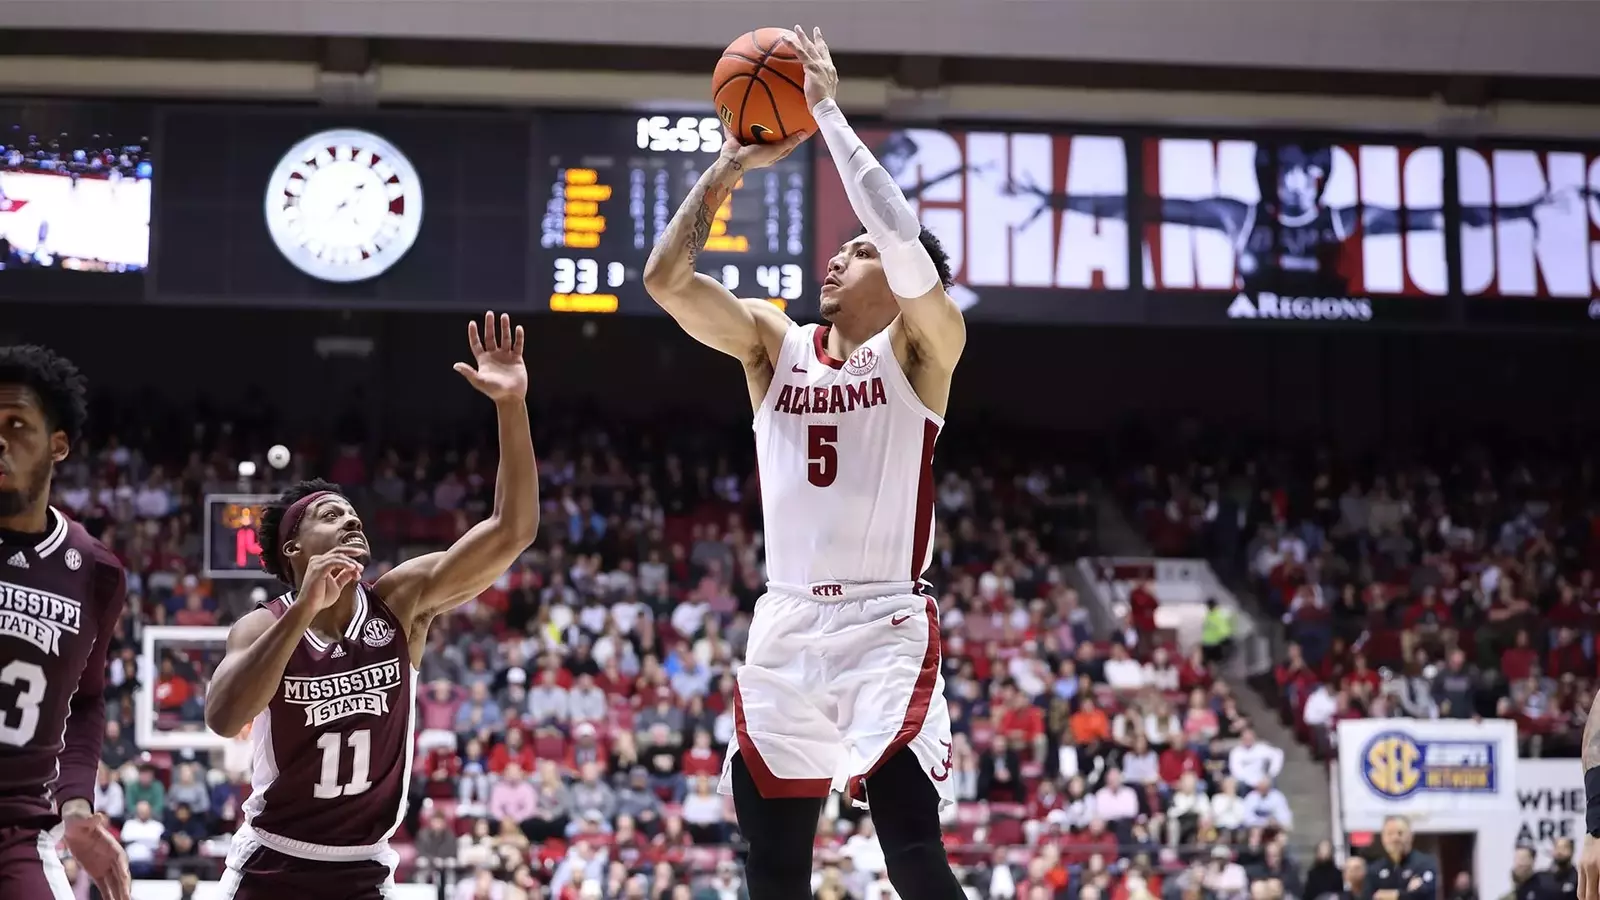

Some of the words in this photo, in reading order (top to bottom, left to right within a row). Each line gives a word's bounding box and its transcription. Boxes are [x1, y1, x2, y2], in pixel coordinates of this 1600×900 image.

[637, 117, 722, 152] 15:55
[888, 128, 1600, 298] CHAMION
[554, 258, 598, 294] 33
[757, 264, 802, 299] 43
[1257, 291, 1372, 320] REGIONS
[850, 348, 873, 368] SEC
[774, 377, 887, 415] ALABAMA
[808, 425, 838, 487] 5
[812, 584, 843, 597] RTR
[366, 620, 388, 640] SEC
[284, 662, 400, 700] MISSISSIPPI
[0, 659, 47, 747] 3
[320, 697, 375, 721] STATE
[313, 729, 372, 799] 11
[1368, 736, 1420, 795] SEC
